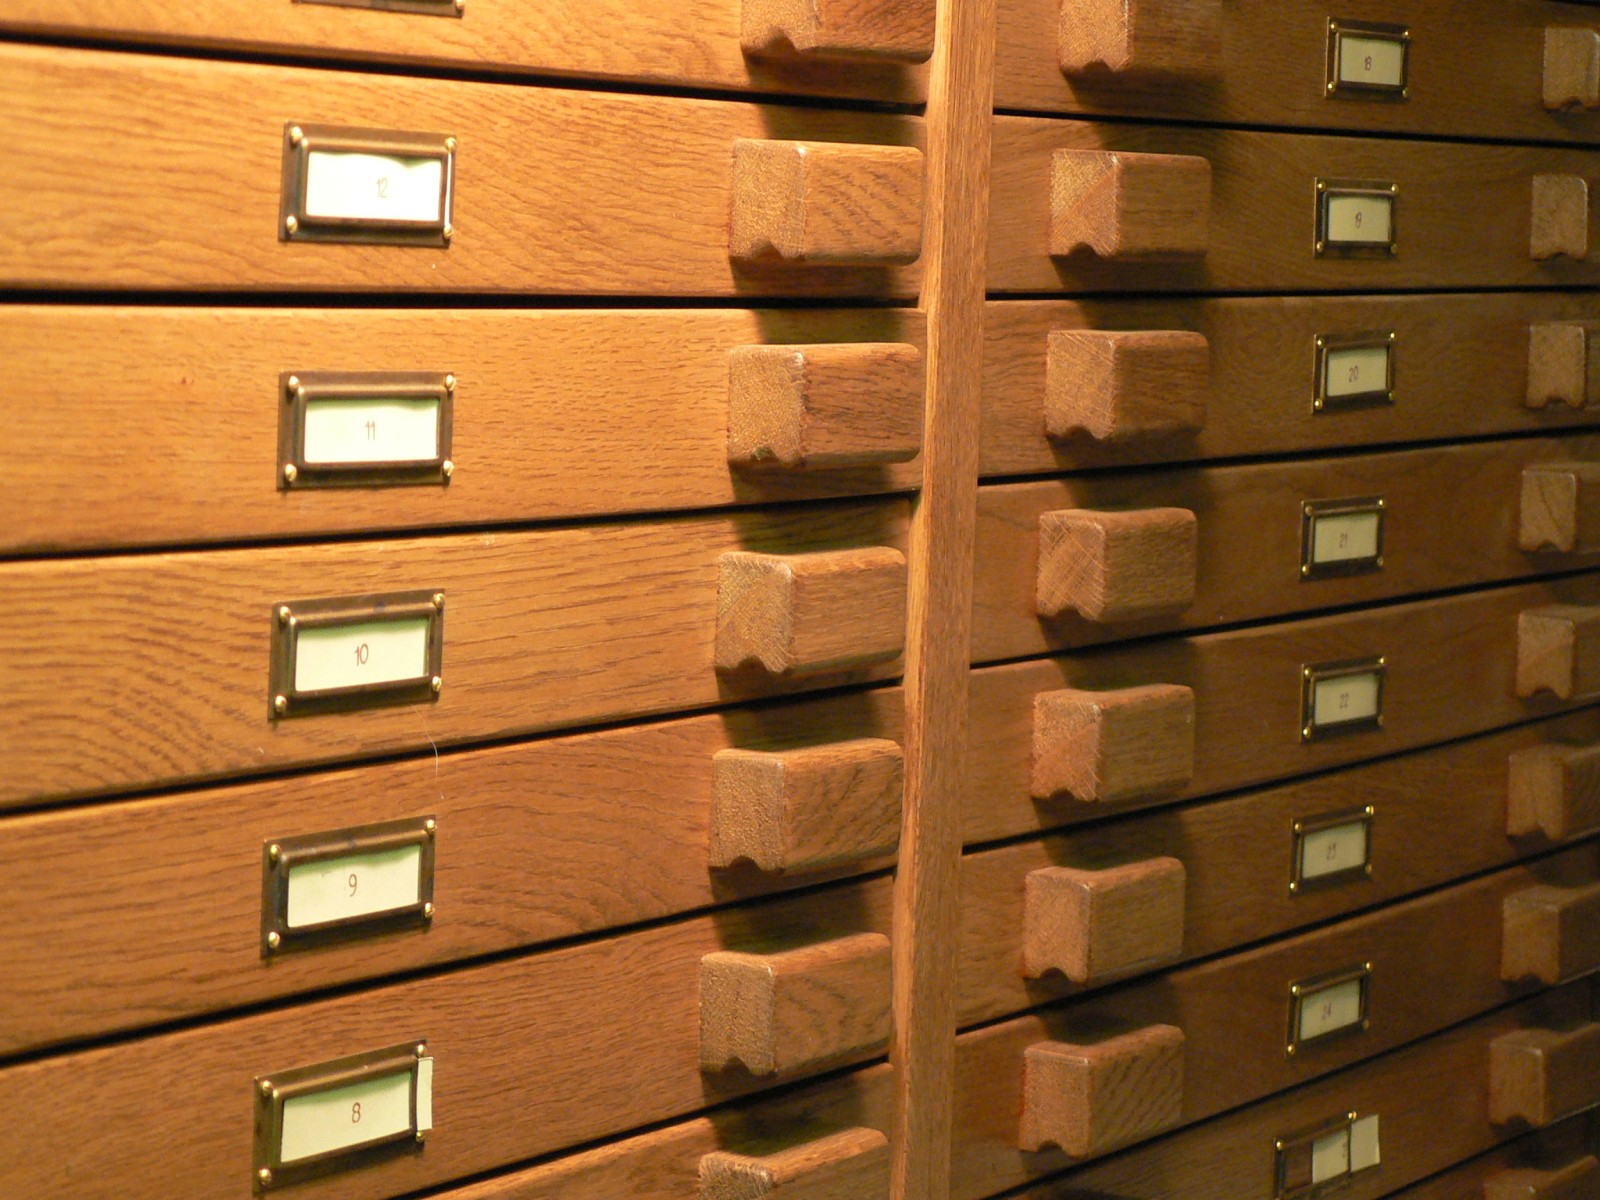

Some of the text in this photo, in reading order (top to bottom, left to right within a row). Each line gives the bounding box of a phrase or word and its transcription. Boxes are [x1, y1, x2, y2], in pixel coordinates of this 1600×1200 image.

[376, 178, 388, 199] 12
[1348, 365, 1359, 382] 20
[364, 420, 376, 441] 11
[354, 643, 369, 667] 10
[1338, 692, 1350, 709] 22
[348, 874, 358, 897] 9
[351, 1102, 361, 1123] 8
